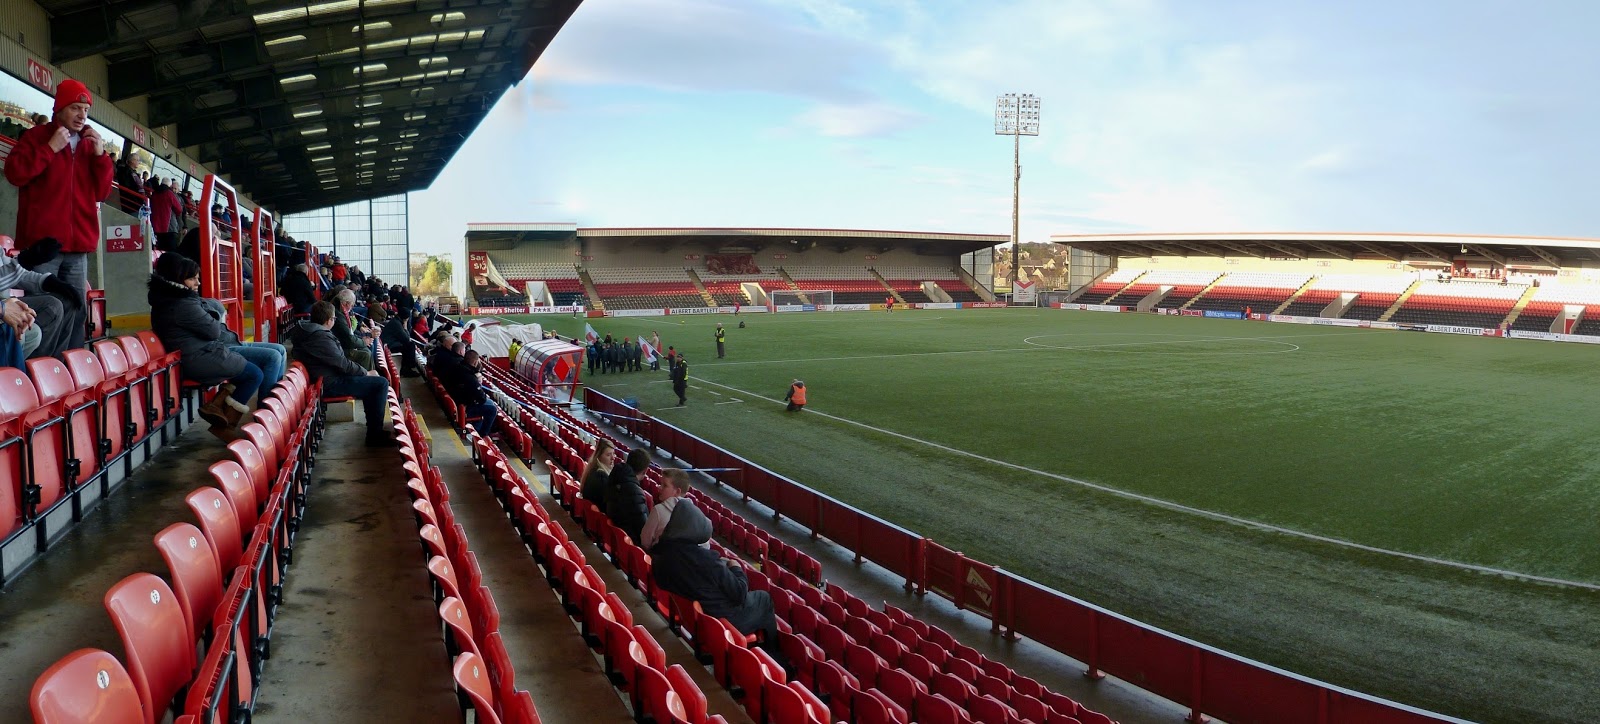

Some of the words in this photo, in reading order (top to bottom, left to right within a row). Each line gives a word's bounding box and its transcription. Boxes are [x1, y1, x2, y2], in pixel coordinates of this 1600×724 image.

[35, 65, 41, 83] C
[42, 69, 48, 87] D
[114, 227, 123, 238] C
[478, 307, 503, 315] Sammy's
[1429, 325, 1452, 333] ALBERT
[1452, 327, 1482, 335] BARTLETT
